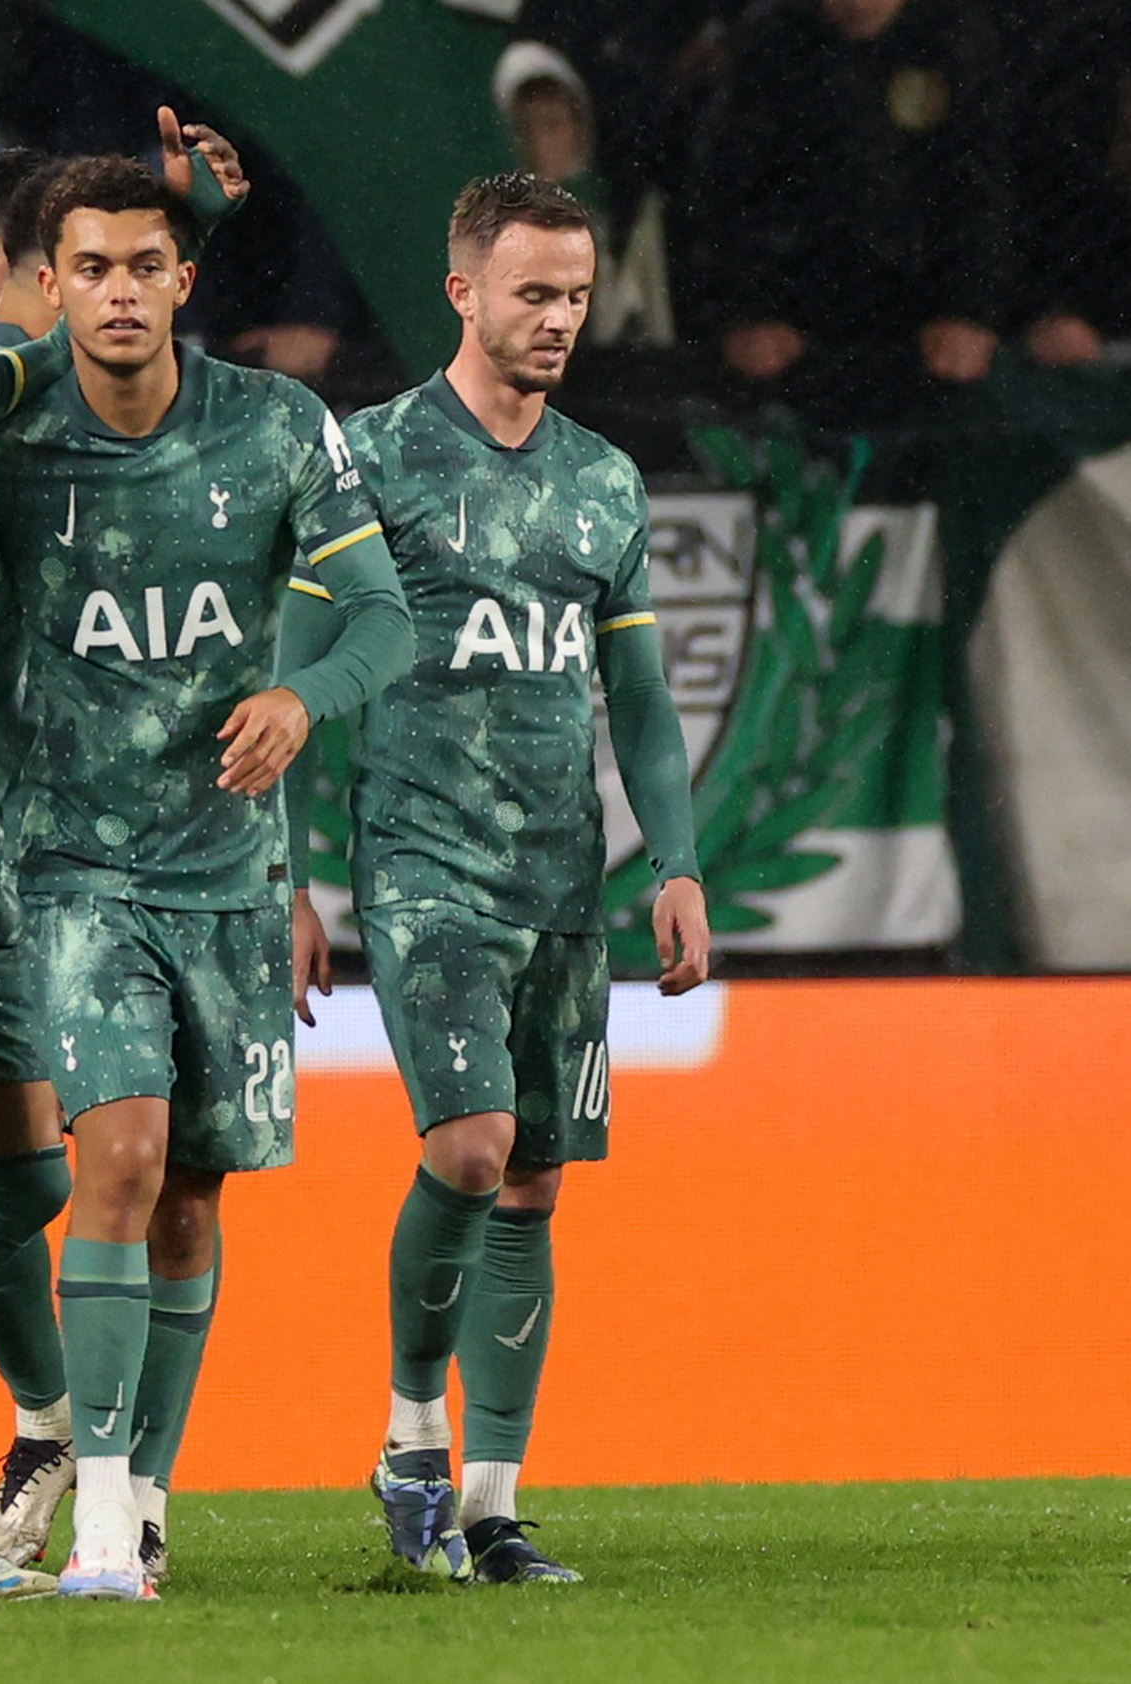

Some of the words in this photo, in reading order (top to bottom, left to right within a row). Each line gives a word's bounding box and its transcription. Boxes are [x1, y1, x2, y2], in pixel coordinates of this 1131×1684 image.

[72, 580, 244, 662] AIA
[449, 597, 589, 673] AIA
[245, 1038, 291, 1122] 22
[572, 1039, 606, 1120] 10
